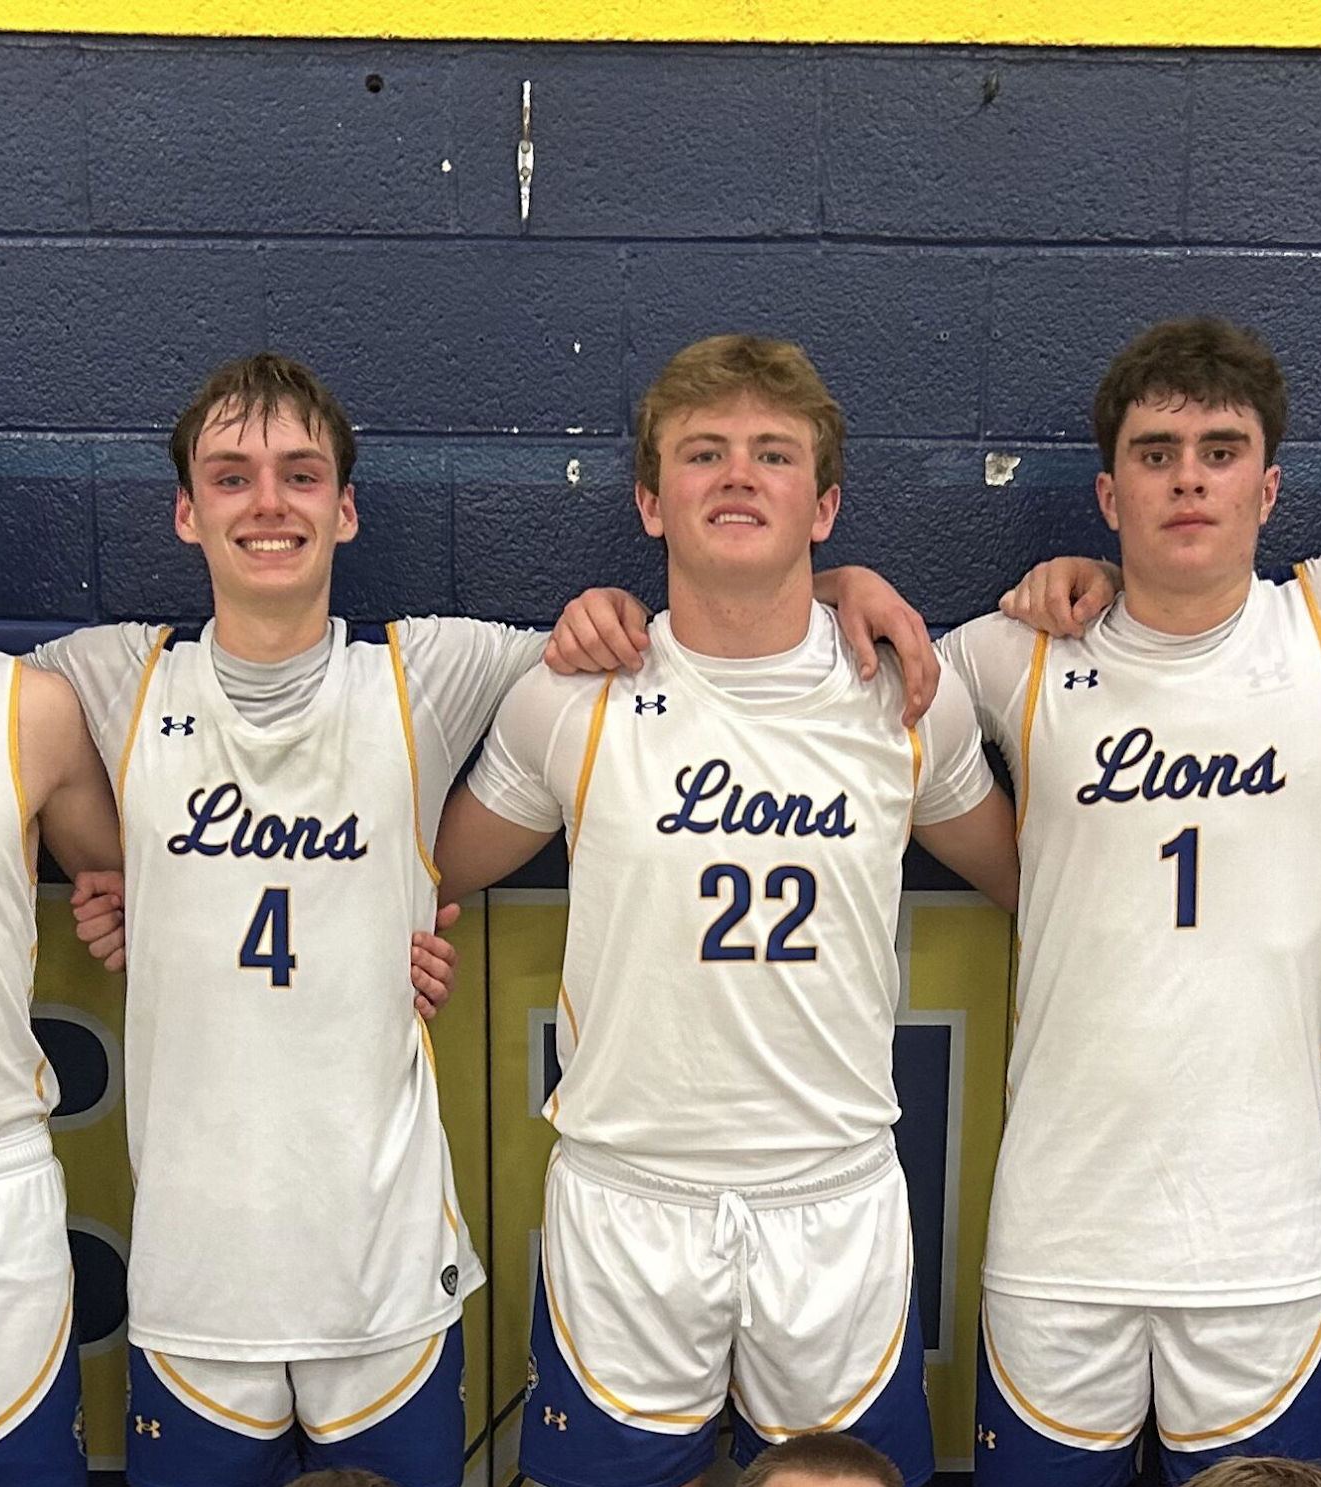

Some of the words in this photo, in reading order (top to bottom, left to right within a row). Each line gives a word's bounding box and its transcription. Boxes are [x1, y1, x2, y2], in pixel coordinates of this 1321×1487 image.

[657, 759, 856, 839] Lions
[1078, 728, 1286, 805] Lions
[167, 783, 368, 861] Lions
[699, 863, 818, 963] 22
[1159, 825, 1201, 929] 1
[238, 885, 297, 989] 4
